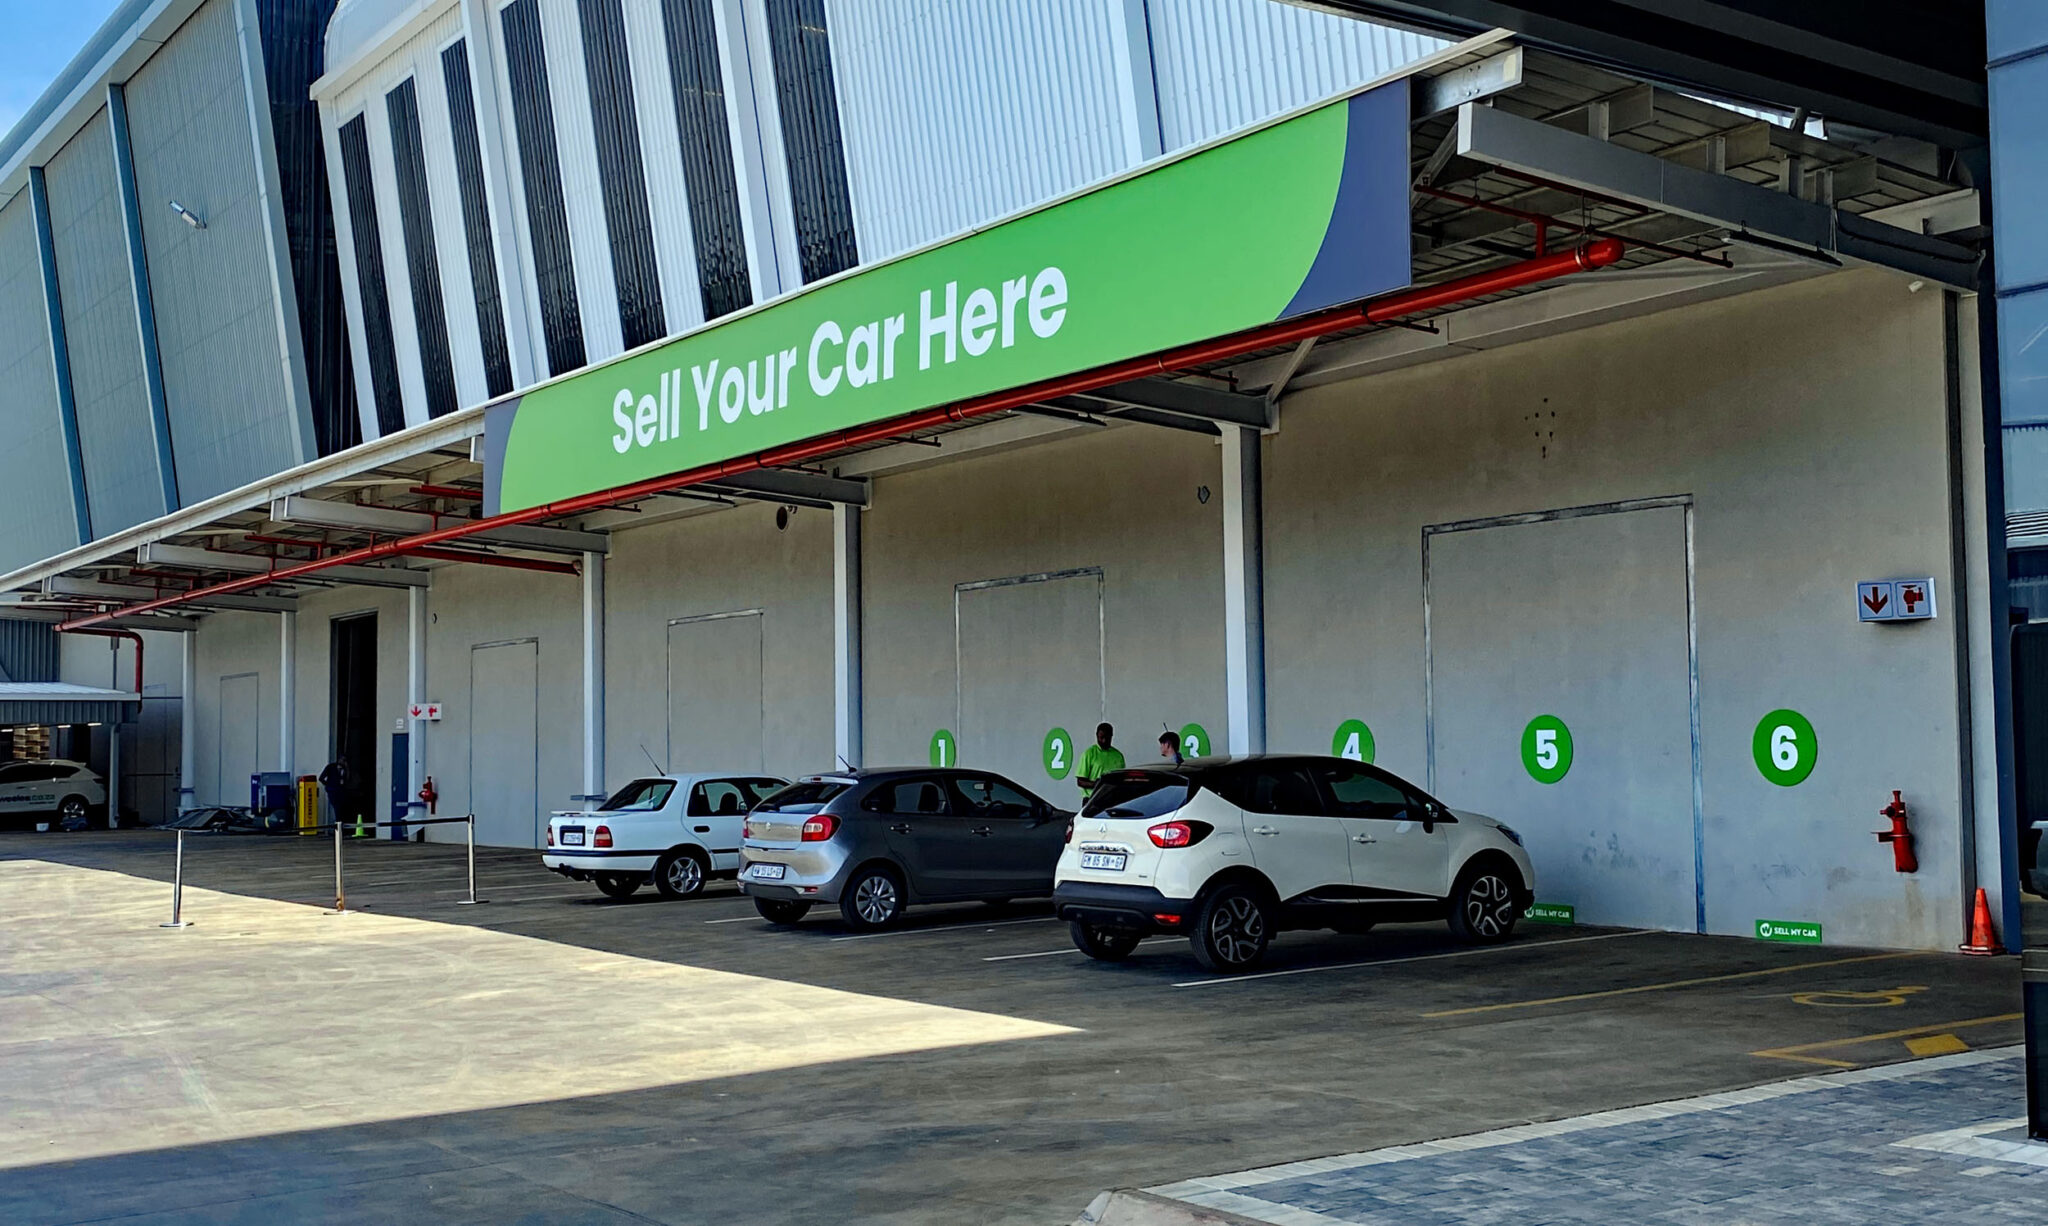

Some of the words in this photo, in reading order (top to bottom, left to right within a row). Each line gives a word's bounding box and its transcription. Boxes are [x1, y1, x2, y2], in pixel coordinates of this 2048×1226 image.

[612, 369, 681, 454] Sell
[691, 346, 797, 432] Your
[808, 313, 905, 397] Car
[918, 267, 1068, 371] Here
[938, 739, 946, 768] 1
[1051, 738, 1064, 769] 2
[1184, 735, 1200, 759] 3
[1341, 732, 1362, 762] 4
[1536, 729, 1559, 770] 5
[1770, 725, 1799, 771] 6
[1774, 927, 1789, 935] SELL
[1791, 928, 1801, 936] MY
[1802, 929, 1817, 937] CAR
